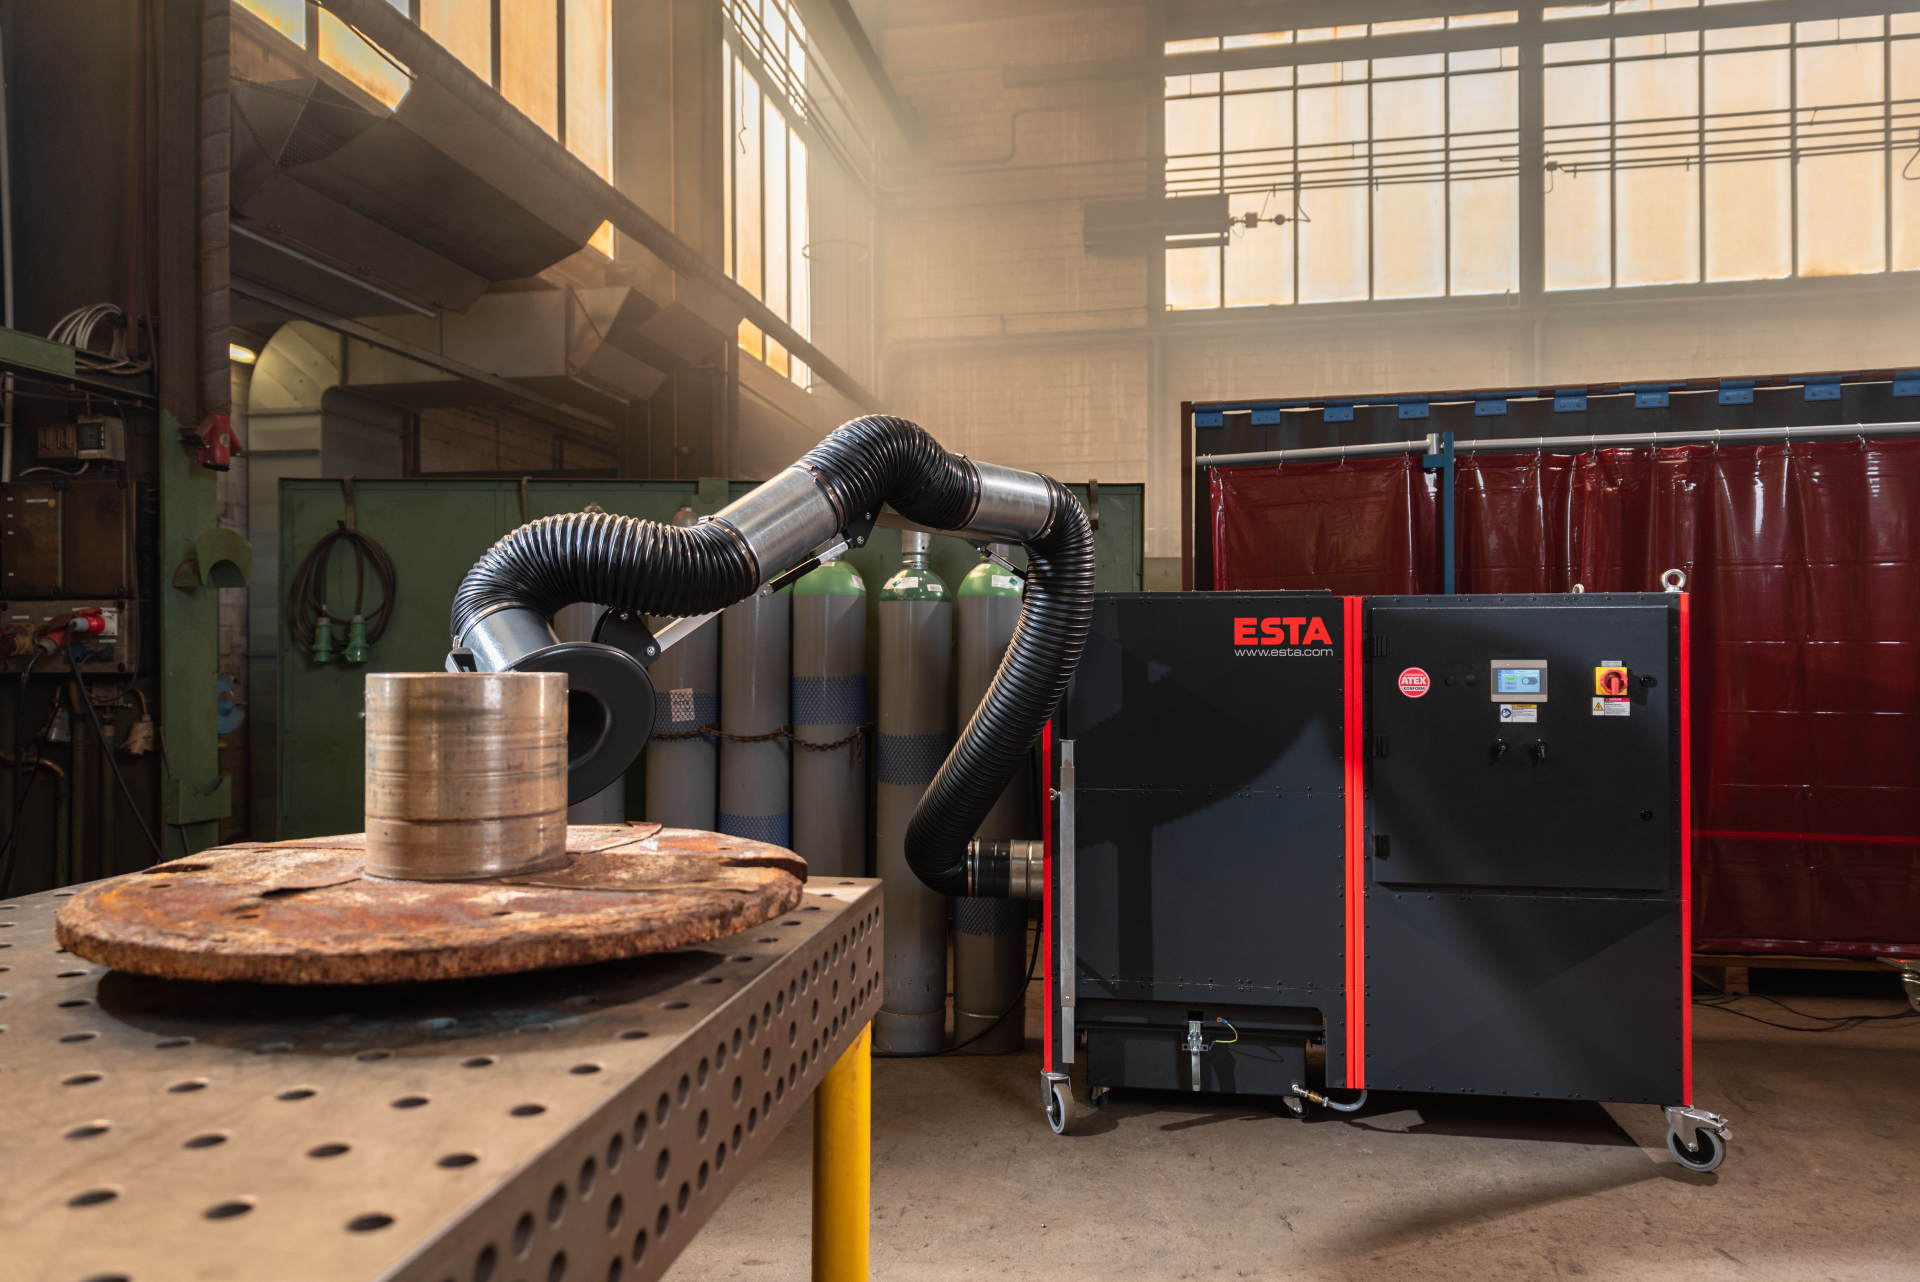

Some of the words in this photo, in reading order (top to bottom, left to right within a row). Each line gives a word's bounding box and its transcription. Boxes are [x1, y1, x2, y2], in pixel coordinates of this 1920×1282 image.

[1234, 616, 1333, 645] ESTA
[1234, 647, 1334, 657] www.esta.com
[1401, 676, 1427, 685] ATEX
